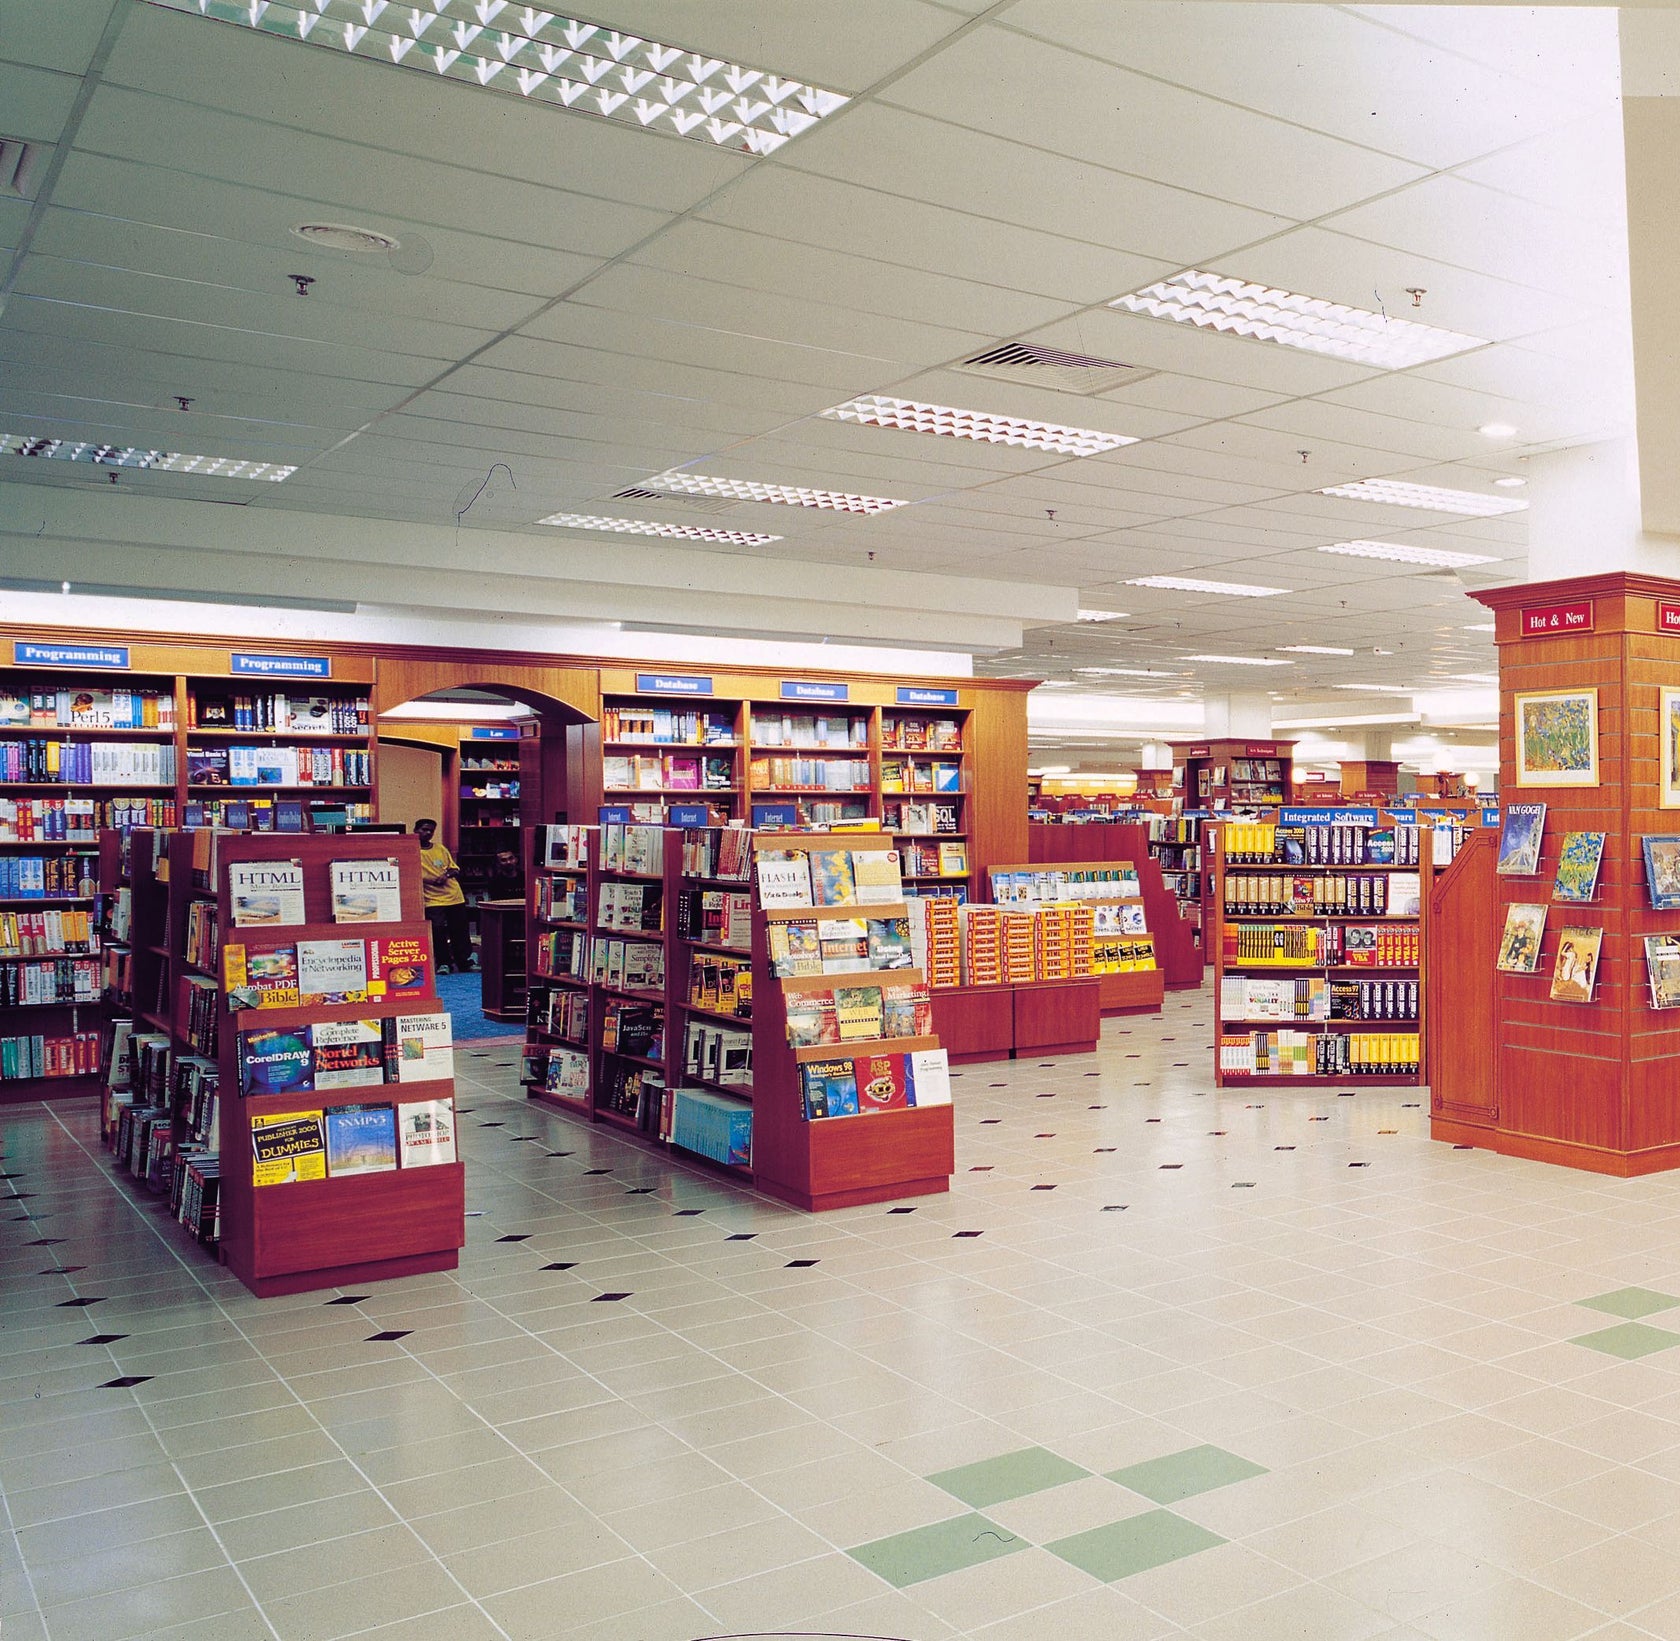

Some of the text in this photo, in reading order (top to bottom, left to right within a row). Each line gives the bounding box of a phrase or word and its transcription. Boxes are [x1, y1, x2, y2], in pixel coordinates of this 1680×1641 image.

[1530, 612, 1585, 628] Hot & New
[25, 647, 121, 664] Programming
[240, 657, 322, 673] Programming
[655, 679, 698, 690] Database
[796, 686, 835, 697] Database
[909, 691, 945, 702] Database
[71, 711, 111, 724] Perl 5
[1284, 811, 1374, 824] Integrated Software
[239, 872, 300, 884] HTML
[340, 871, 397, 882] HTML
[388, 948, 420, 956] Server
[302, 956, 362, 967] Encyclopedia
[382, 954, 427, 964] Pages 2.0
[275, 979, 297, 989] PDF
[260, 991, 297, 1003] Bible
[401, 1023, 437, 1033] NETWARE
[246, 1051, 310, 1064] CorelDRAW
[315, 1048, 358, 1059] Nortel
[300, 1059, 309, 1067] 9
[316, 1056, 380, 1070] Networks
[807, 1063, 841, 1073] Windows
[261, 1138, 319, 1159] DUMMIES
